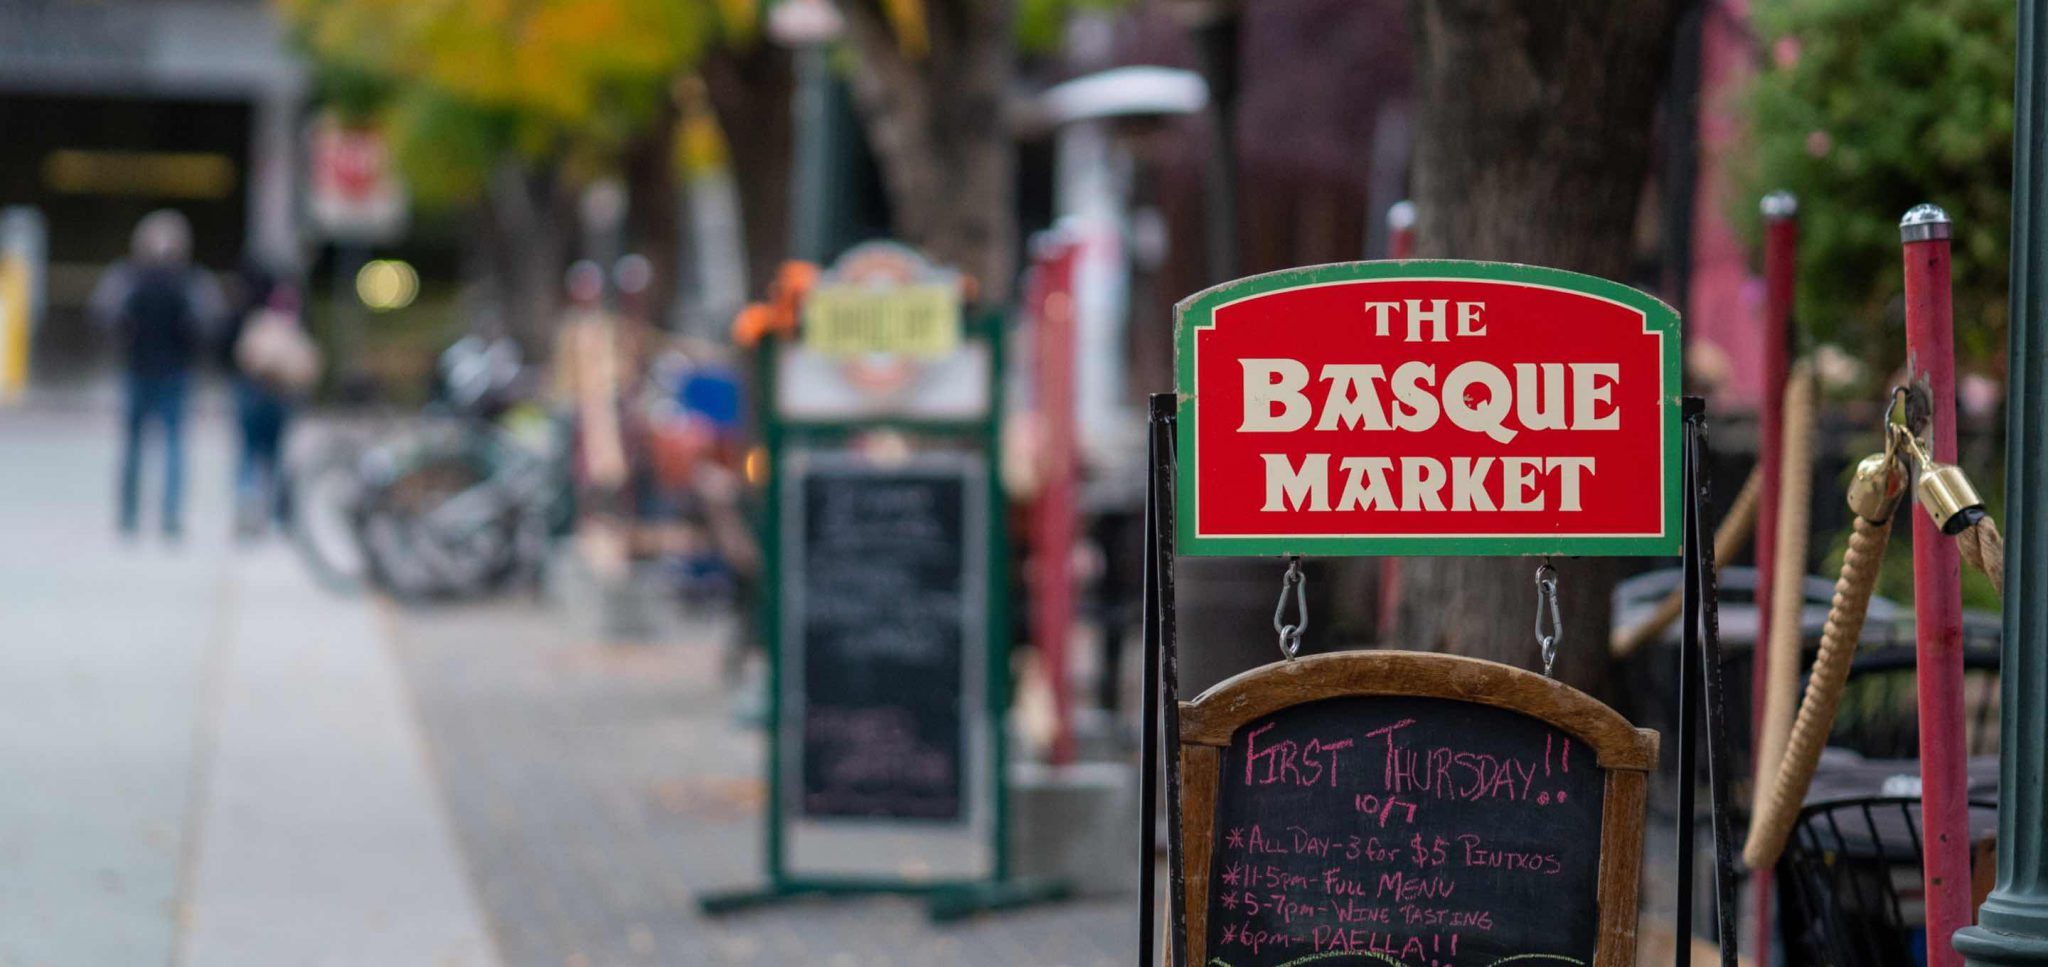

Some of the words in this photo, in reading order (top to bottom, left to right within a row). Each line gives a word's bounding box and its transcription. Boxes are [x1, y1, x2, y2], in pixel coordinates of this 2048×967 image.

[1365, 299, 1487, 343] THE
[1236, 358, 1621, 444] BASQUE
[1259, 453, 1596, 512] MARKET
[1245, 722, 1354, 787] FIRST
[1355, 794, 1417, 828] 10/7
[1411, 832, 1450, 868] $5
[1377, 871, 1455, 901] MENU
